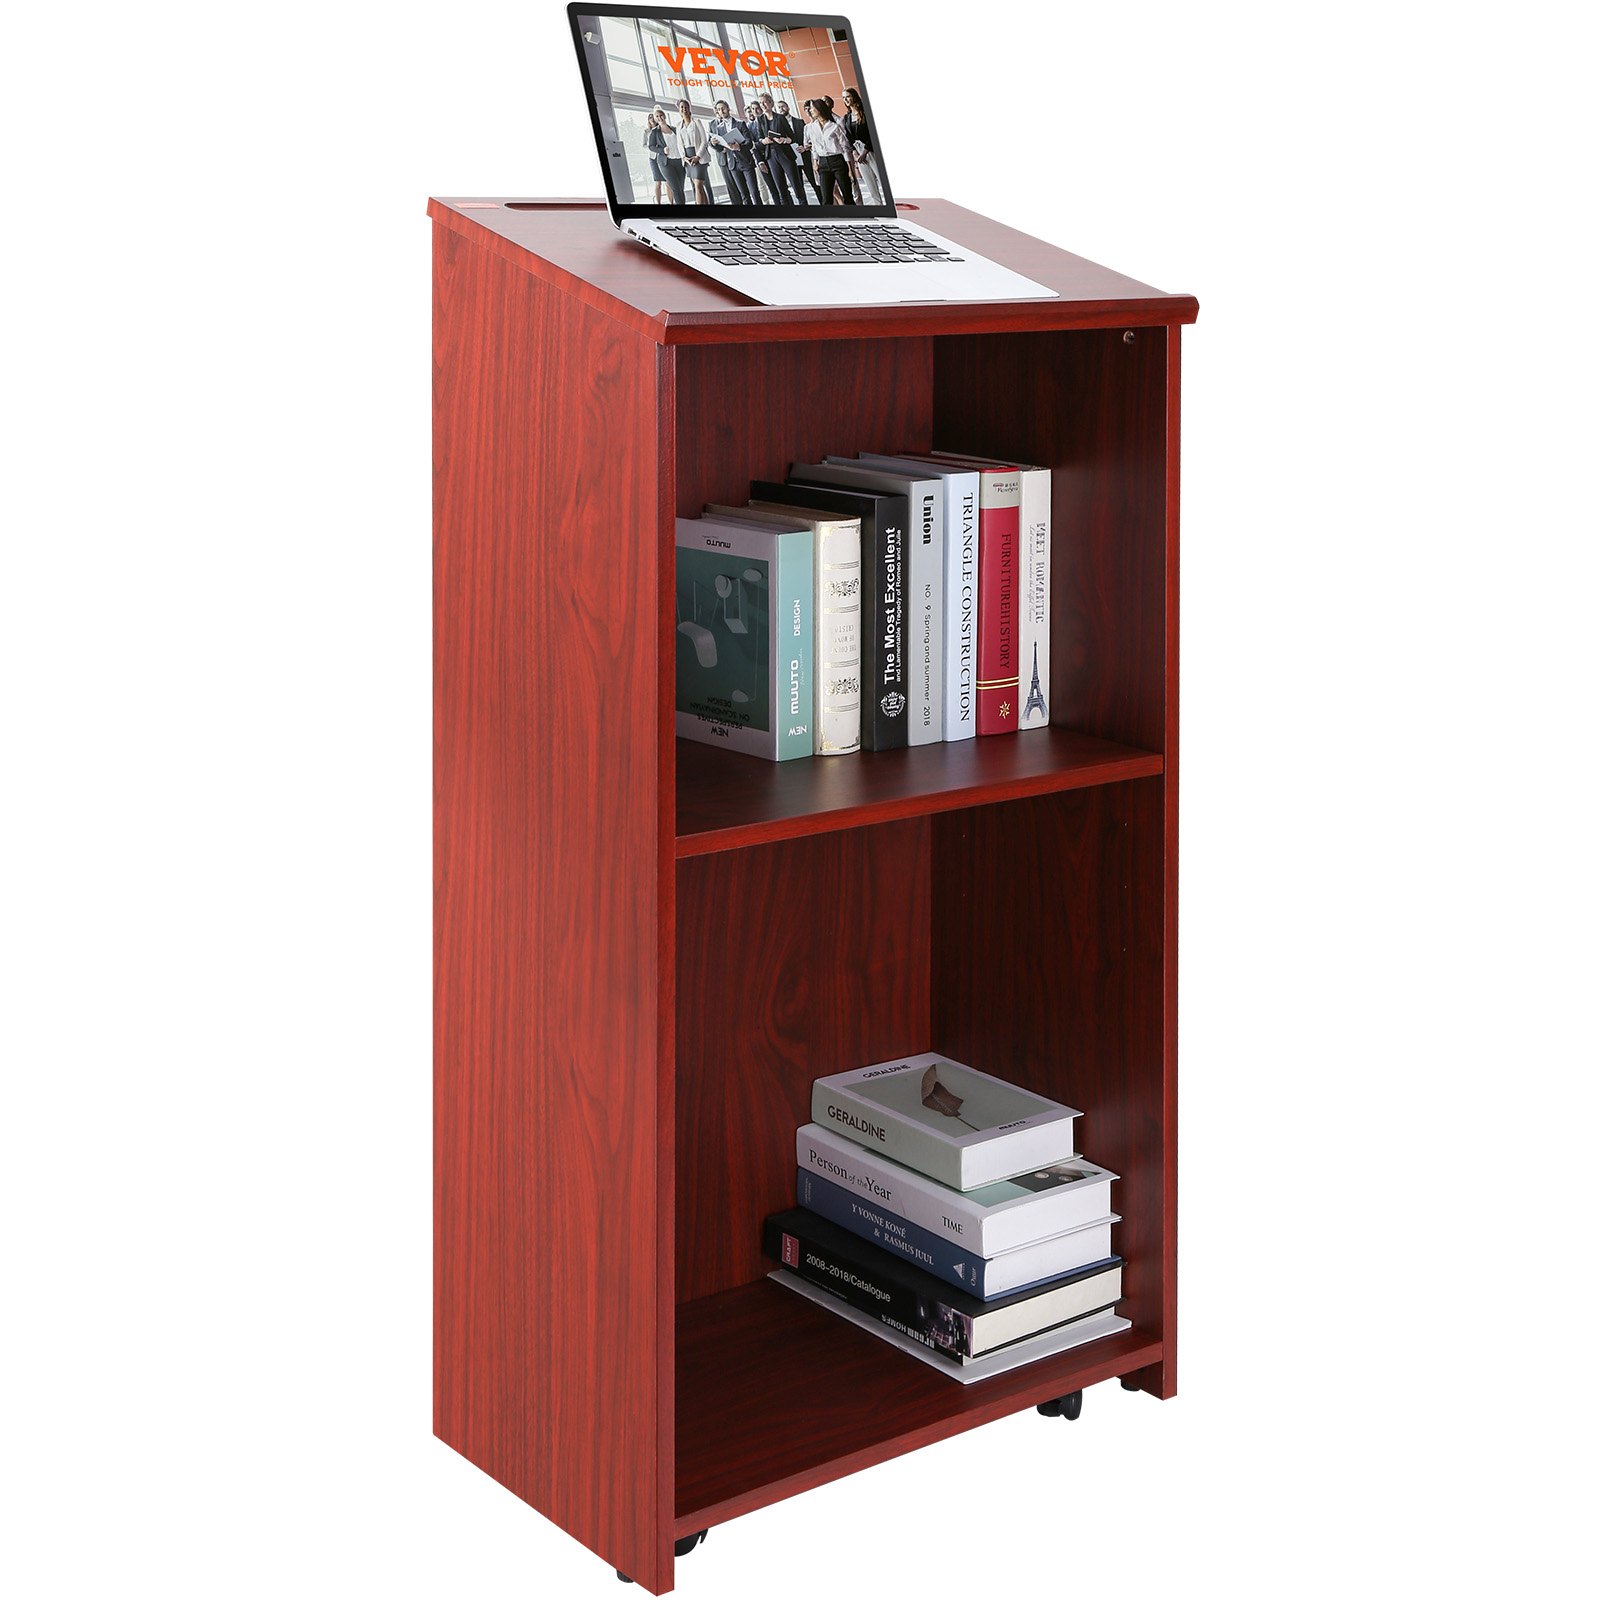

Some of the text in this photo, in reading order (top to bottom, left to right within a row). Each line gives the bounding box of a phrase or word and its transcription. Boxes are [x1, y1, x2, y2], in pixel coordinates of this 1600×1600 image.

[657, 45, 791, 77] VEVOR
[667, 78, 703, 88] TOUGH
[923, 495, 934, 545] Union
[896, 588, 901, 596] of
[884, 527, 895, 685] The Most Excellent
[960, 492, 973, 721] TRIANGLE CONSTRUCTION
[923, 614, 931, 644] Spring
[923, 706, 931, 727] 2018
[711, 726, 728, 737] NEW
[788, 725, 807, 737] NEW
[862, 1064, 911, 1078] GERALDINE
[827, 1105, 886, 1142] GERALDINE
[809, 1149, 892, 1200] Person of the Year
[885, 1221, 907, 1238] KONÉ
[942, 1216, 964, 1234] TIME
[873, 1228, 934, 1265] & RASMUS JUUL
[881, 1314, 907, 1332] HOMES
